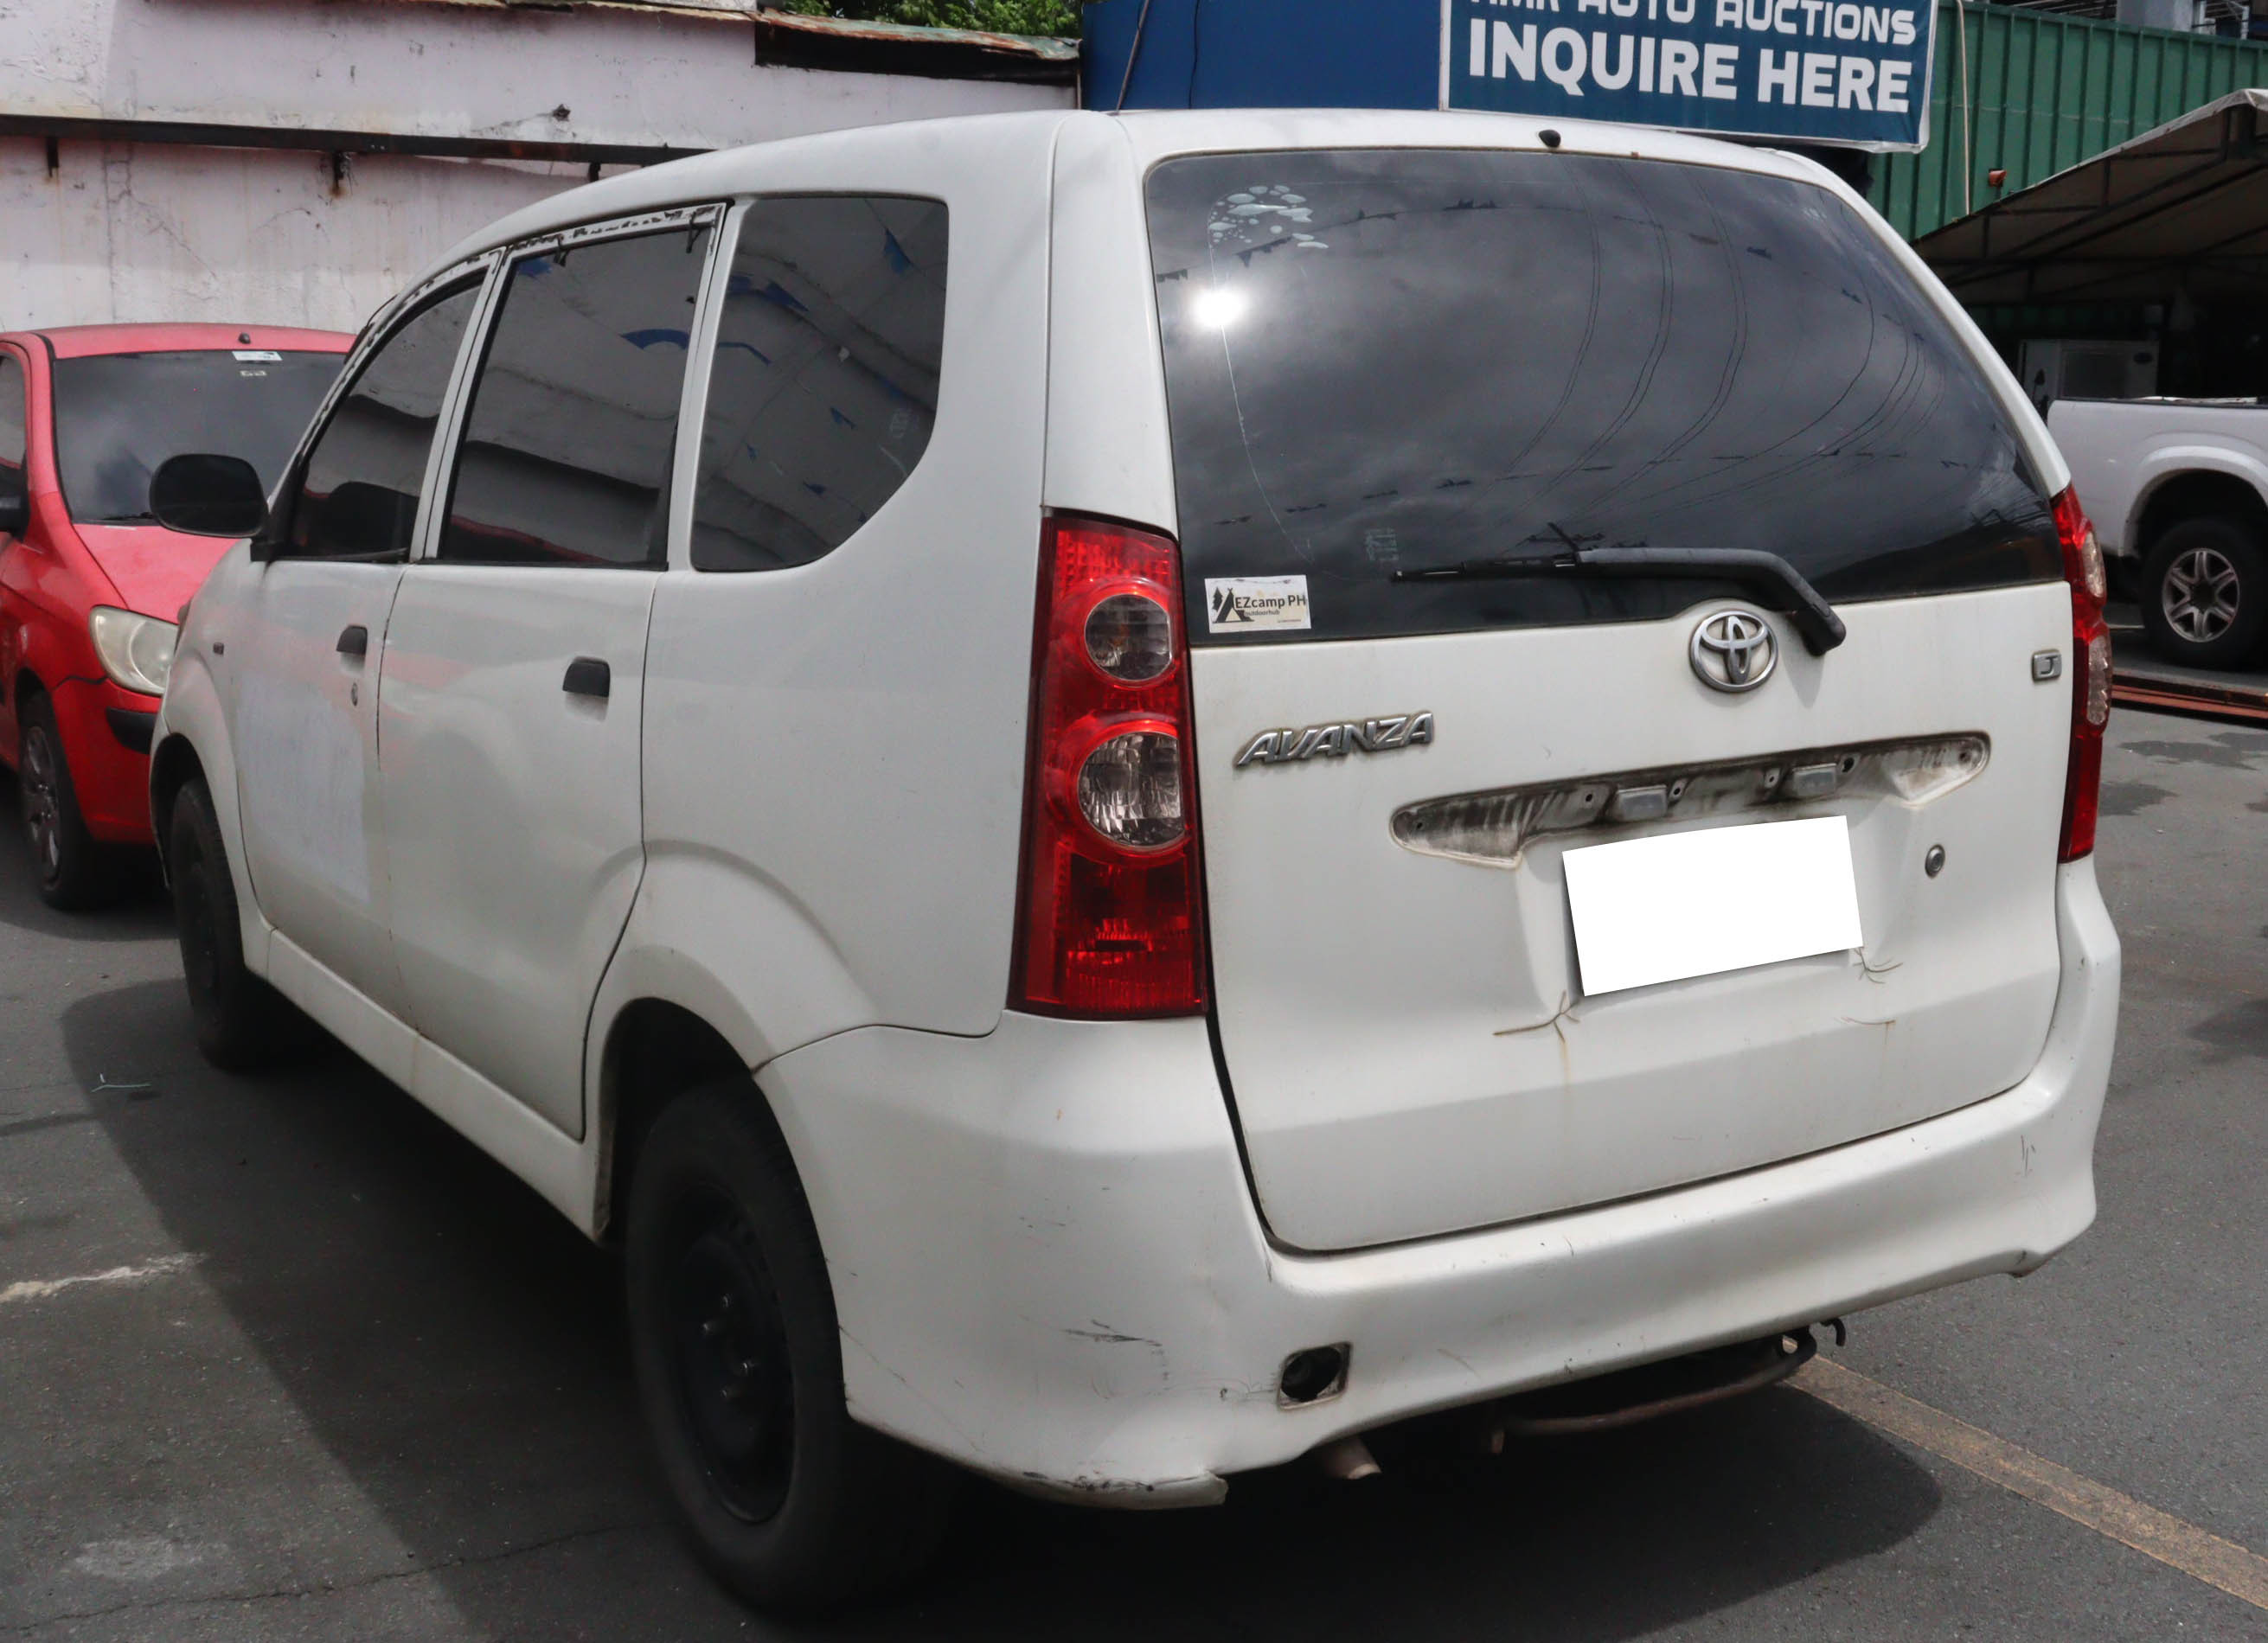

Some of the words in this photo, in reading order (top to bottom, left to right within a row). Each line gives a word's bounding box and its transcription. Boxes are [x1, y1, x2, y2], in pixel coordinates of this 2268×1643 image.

[1715, 0, 1916, 45] AUCTIONS
[1470, 18, 1739, 99] INQUIRE
[1758, 48, 1912, 112] HERE
[1235, 596, 1285, 609] EZcamp
[1288, 594, 1306, 606] PH
[2041, 655, 2059, 675] J
[1234, 711, 1433, 768] AVANZA
